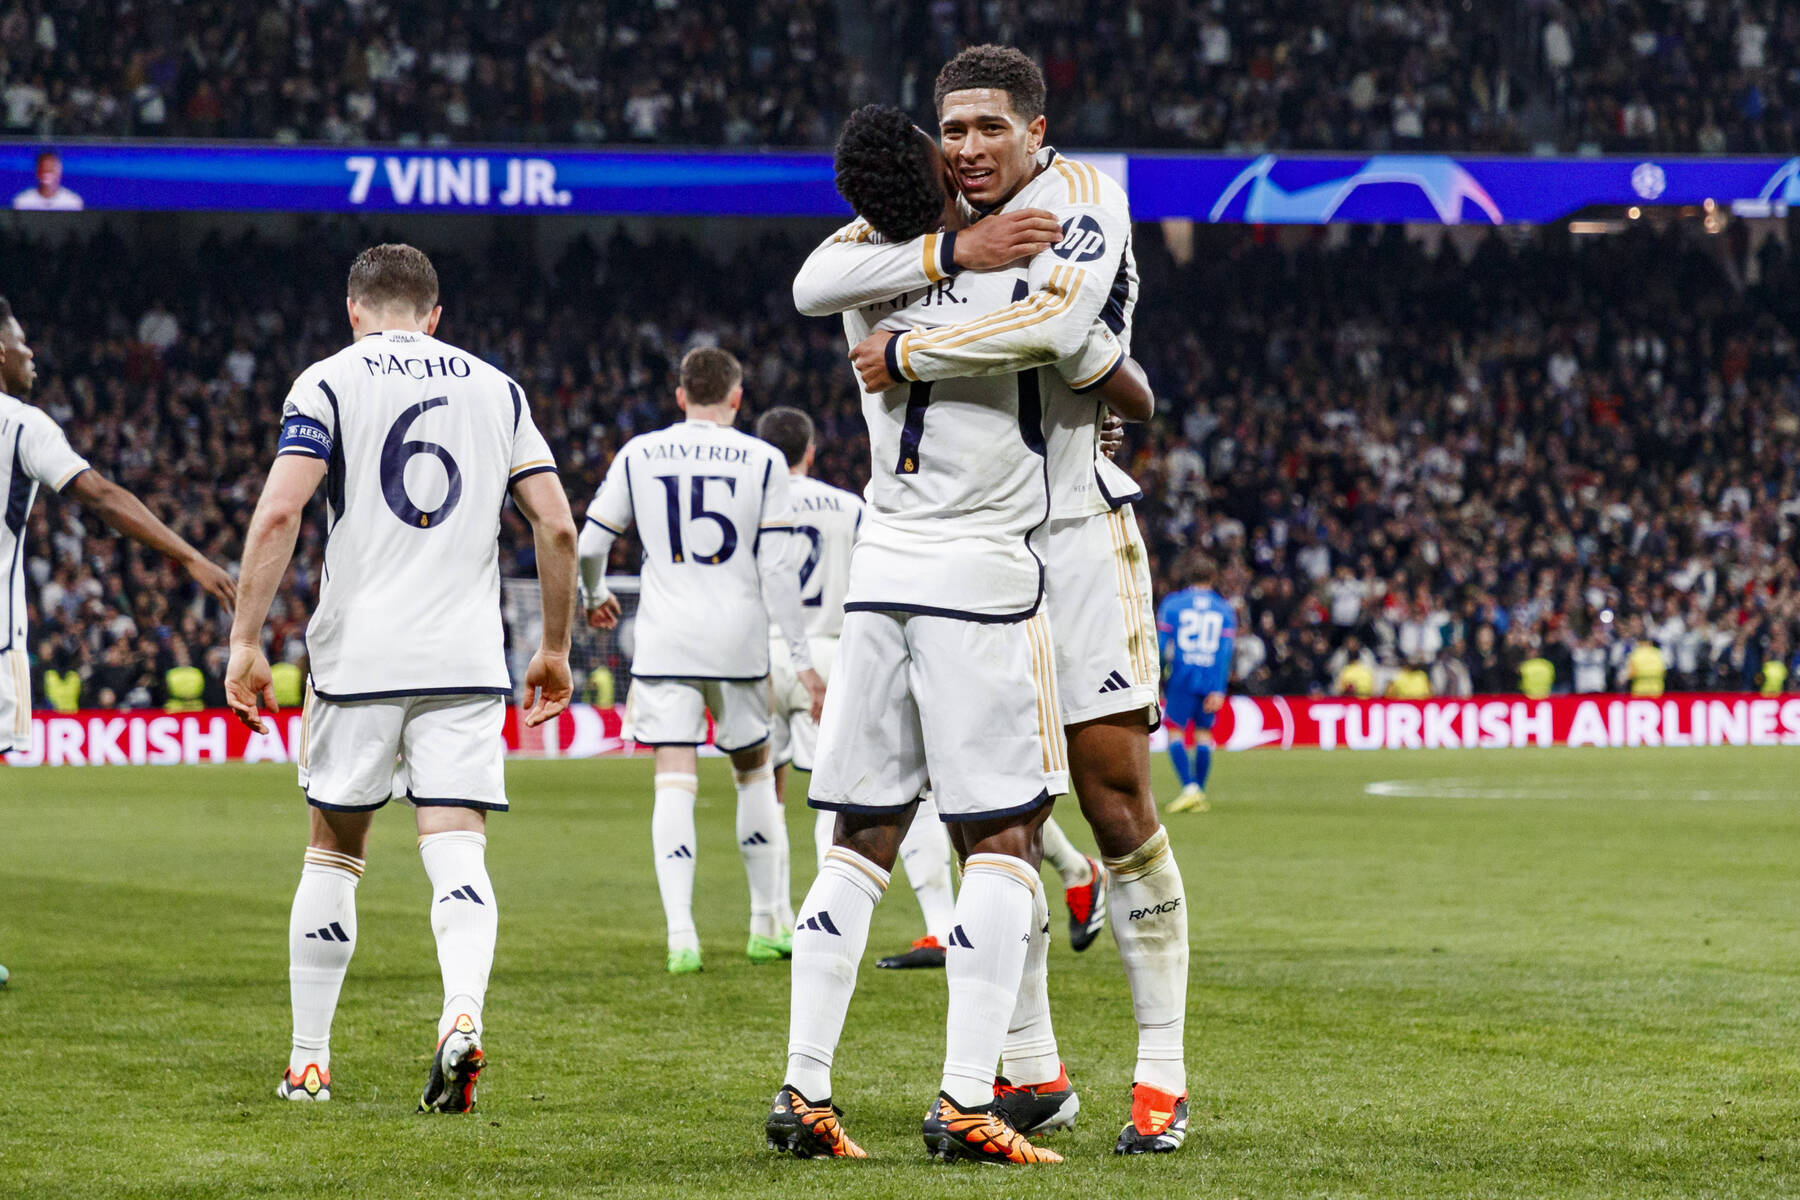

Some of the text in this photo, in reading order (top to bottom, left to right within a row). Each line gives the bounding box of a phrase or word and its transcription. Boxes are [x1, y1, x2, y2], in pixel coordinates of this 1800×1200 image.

[346, 156, 572, 206] 7 VINI JR.
[1053, 215, 1104, 262] hp
[922, 277, 967, 307] JR.
[363, 354, 470, 379] NACHO
[300, 427, 332, 450] RESPEC
[642, 444, 753, 465] VALVERDE
[380, 396, 462, 529] 6
[653, 475, 738, 565] 15
[1177, 608, 1224, 654] 20
[5, 716, 227, 766] URKISH
[1308, 700, 1800, 750] TURKISH AIRLINES
[1129, 898, 1181, 920] RMCF
